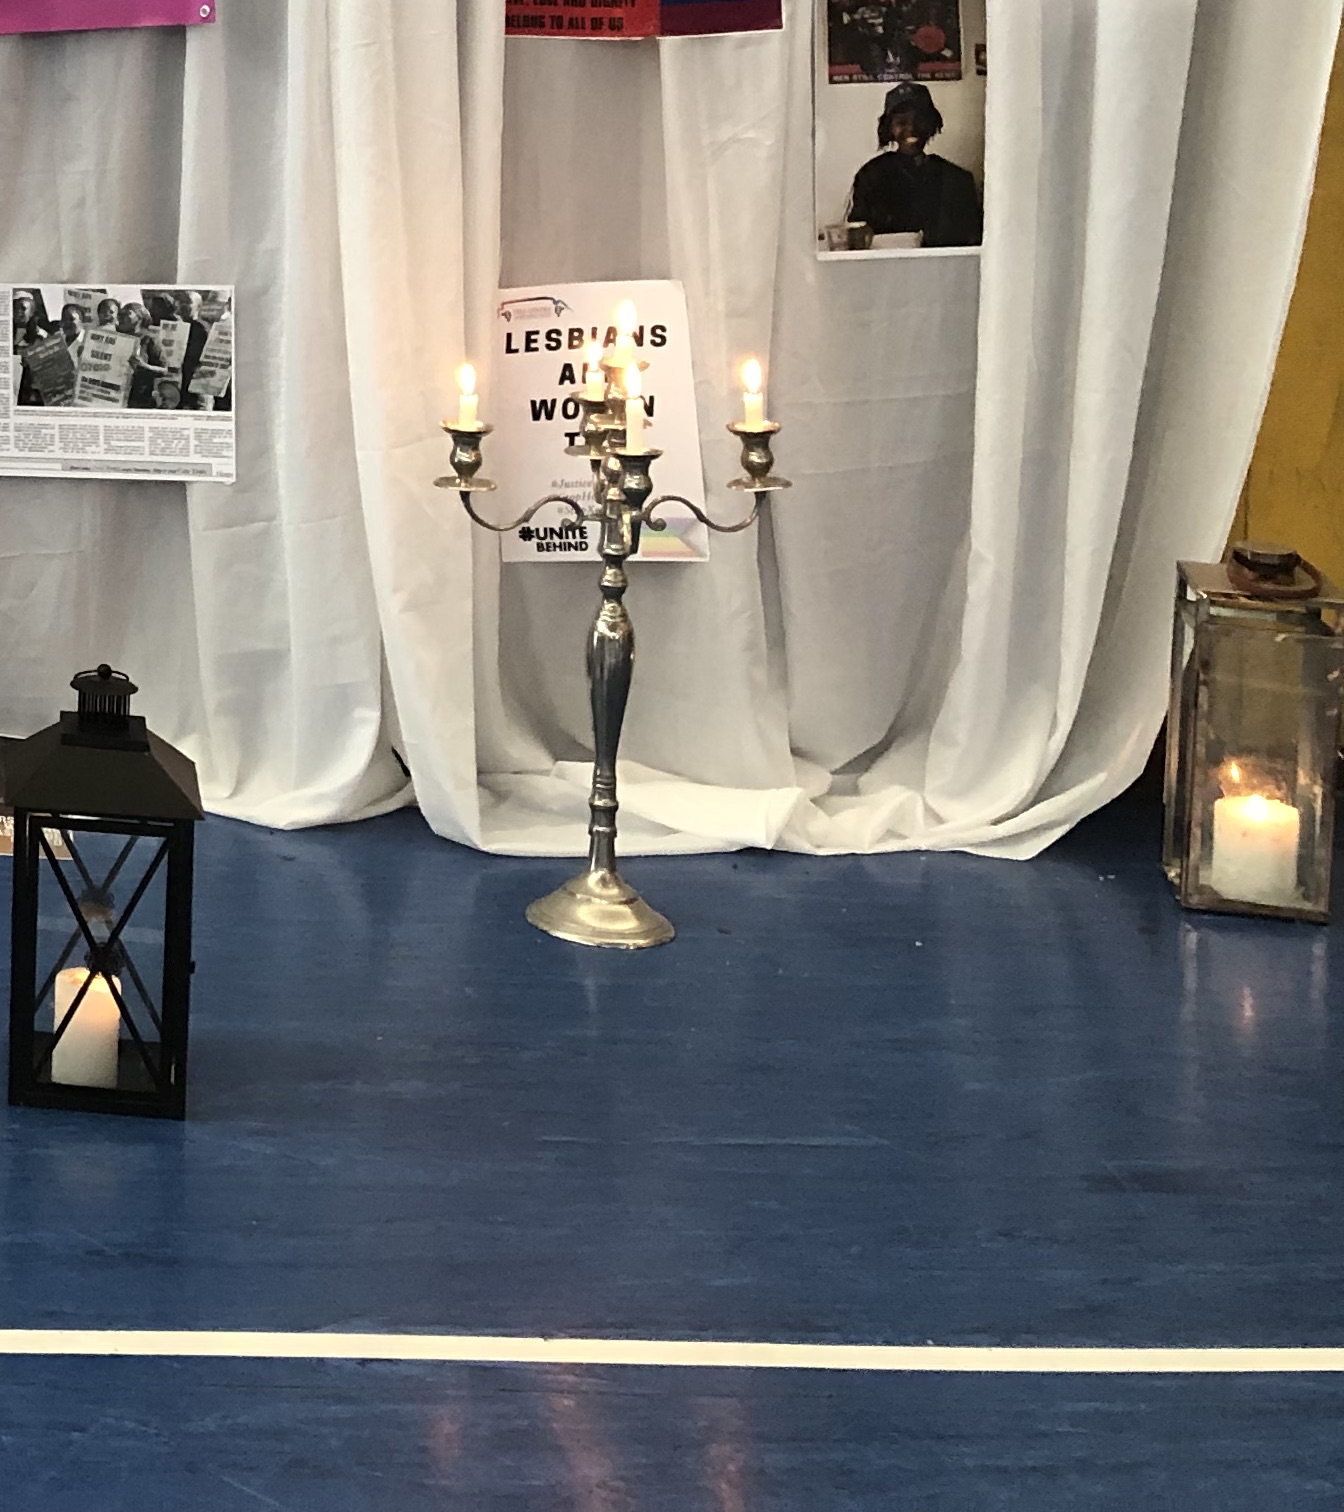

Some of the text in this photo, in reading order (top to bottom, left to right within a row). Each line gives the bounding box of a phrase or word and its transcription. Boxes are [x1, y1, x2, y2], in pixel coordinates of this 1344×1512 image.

[549, 15, 563, 30] TO
[567, 17, 586, 30] ALL
[590, 17, 605, 30] OF
[505, 324, 668, 354] LESBIANS
[536, 541, 589, 553] BEHIND
